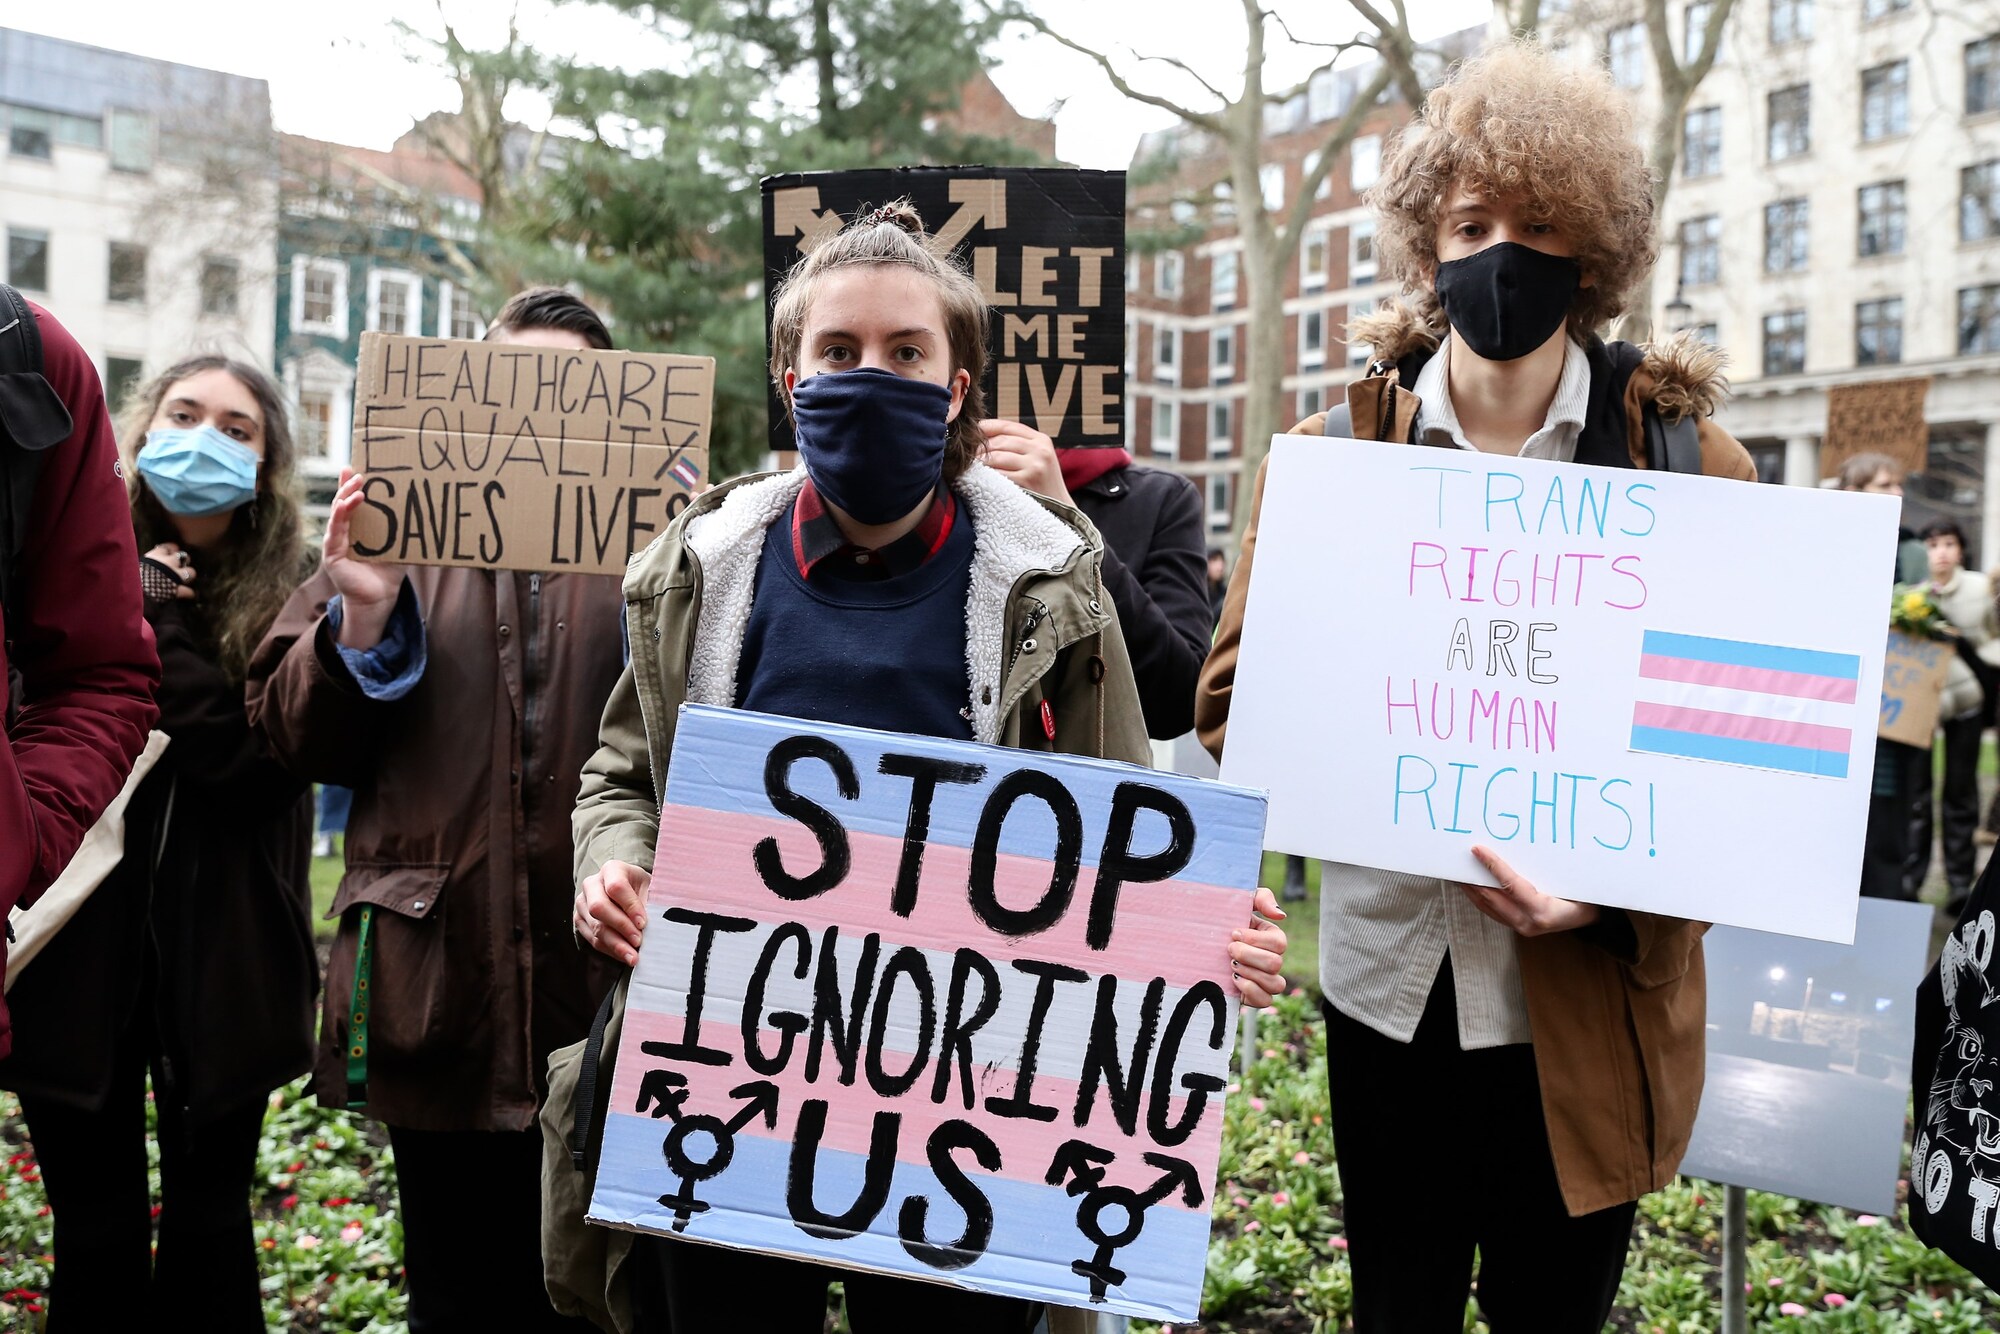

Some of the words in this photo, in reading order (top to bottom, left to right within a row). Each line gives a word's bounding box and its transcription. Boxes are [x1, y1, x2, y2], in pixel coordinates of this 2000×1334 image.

[973, 245, 1114, 307] LET
[1004, 313, 1089, 359] ME
[384, 344, 704, 426] HEALTHCARE
[997, 362, 1120, 438] IVE
[362, 405, 699, 481] EQUALITY
[352, 476, 506, 564] SAVES
[1409, 466, 1656, 538] TRANS
[1408, 541, 1647, 610] RIGHTS
[1446, 618, 1559, 684] ARE
[1385, 675, 1558, 753] HUMAN
[752, 735, 1198, 952] STOP
[1393, 754, 1657, 858] RIGHTS!
[640, 906, 1230, 1147] IGNORING
[785, 1098, 1003, 1271] US
